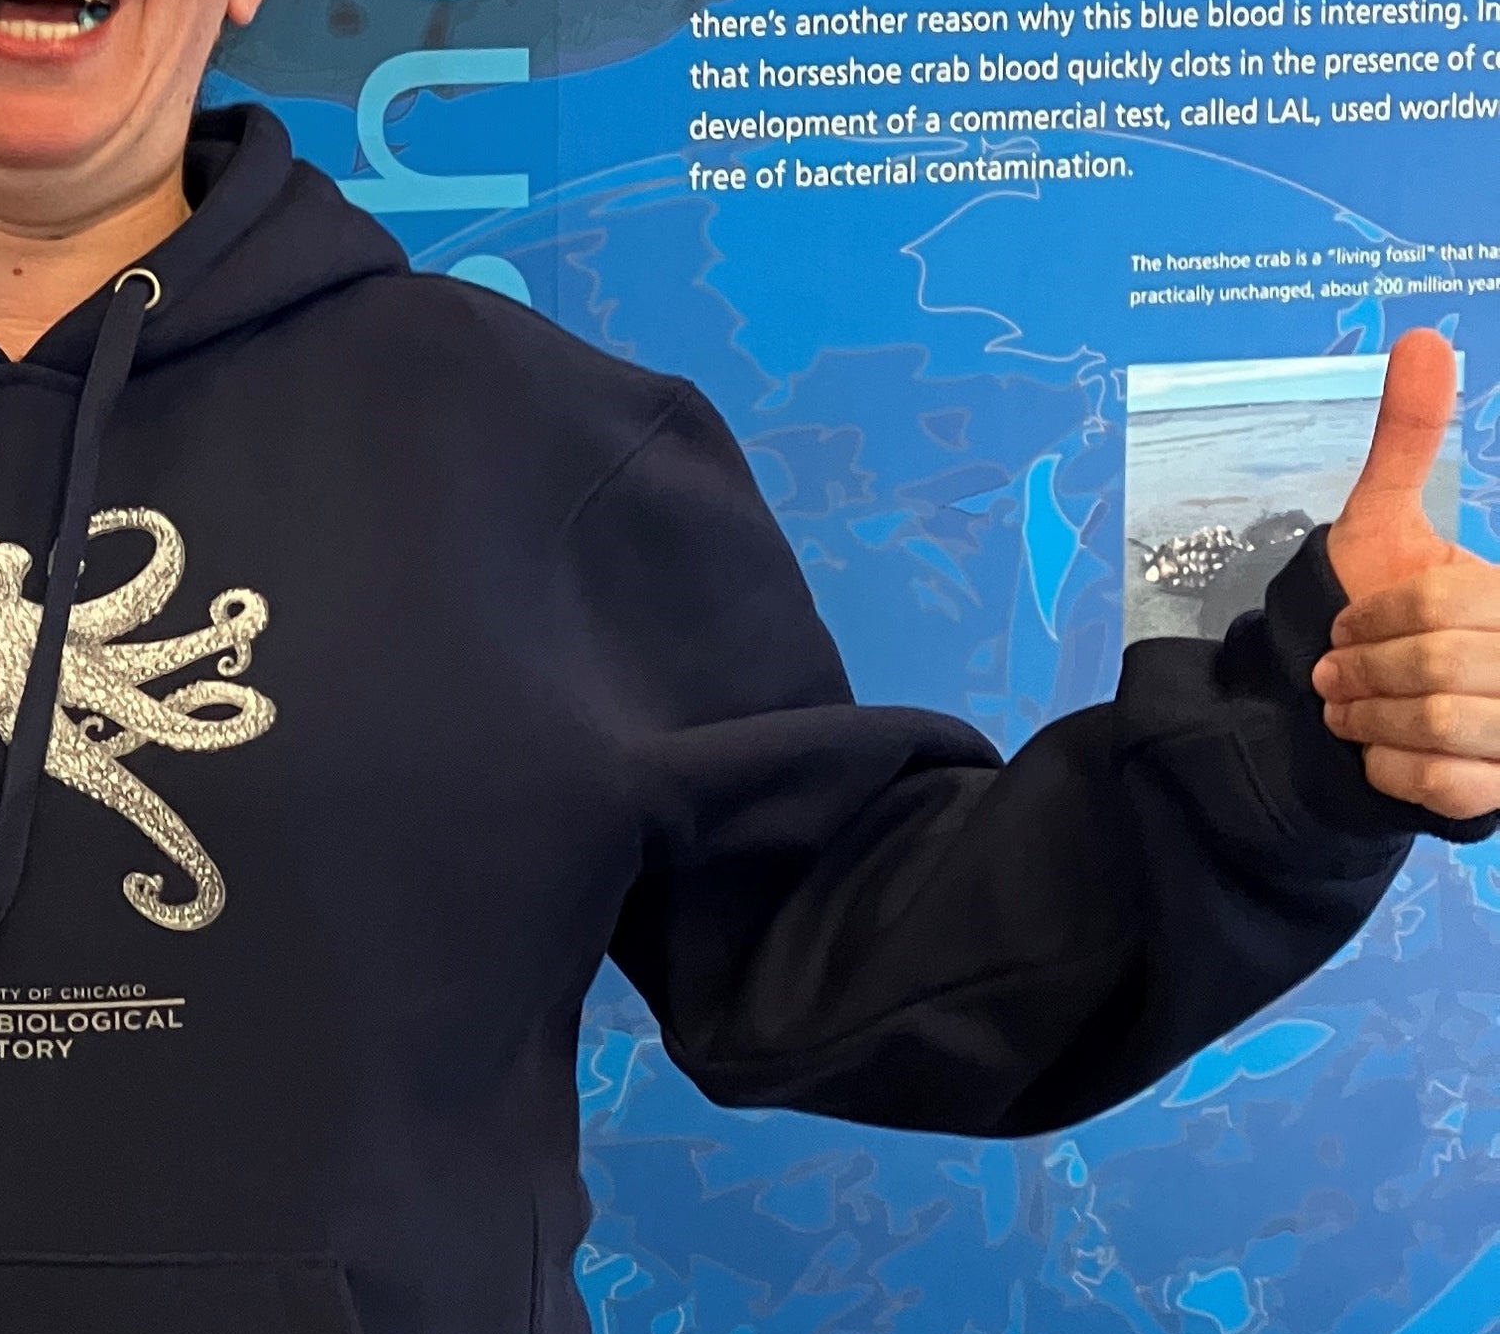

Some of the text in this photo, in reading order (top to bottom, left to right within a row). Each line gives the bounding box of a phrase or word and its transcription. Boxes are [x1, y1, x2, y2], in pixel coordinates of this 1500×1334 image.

[689, 9, 787, 38] there's
[795, 5, 908, 36] another
[917, 10, 1008, 33] reason
[1017, 2, 1075, 38] why
[1083, 1, 1132, 30] this
[1140, 0, 1199, 29] blue
[1293, 0, 1312, 26] is
[689, 60, 749, 90] that
[759, 57, 902, 87] horseshoe
[910, 55, 970, 84] crab
[979, 52, 1059, 82] blood
[1067, 50, 1163, 86] quickly
[1170, 49, 1231, 78] clots
[1240, 49, 1264, 76] in
[1272, 47, 1317, 75] the
[1324, 51, 1440, 80] presence
[1447, 43, 1476, 72] of
[689, 91, 1500, 144] development of a commercial test, called LAL, used worldw
[689, 151, 1133, 190] free of bacterial contamination.
[1131, 255, 1162, 272] The
[1166, 252, 1251, 270] horseshoe
[1255, 251, 1291, 268] crab
[1296, 248, 1308, 266] is
[1312, 252, 1322, 265] a
[1440, 243, 1473, 261] that
[1130, 285, 1214, 308] practically
[1219, 282, 1315, 303] unchanged,
[1320, 281, 1369, 297] about
[1374, 277, 1403, 295] 200
[1407, 276, 1463, 294] million
[28, 987, 52, 1001] OF
[60, 983, 146, 1000] CHICAGO
